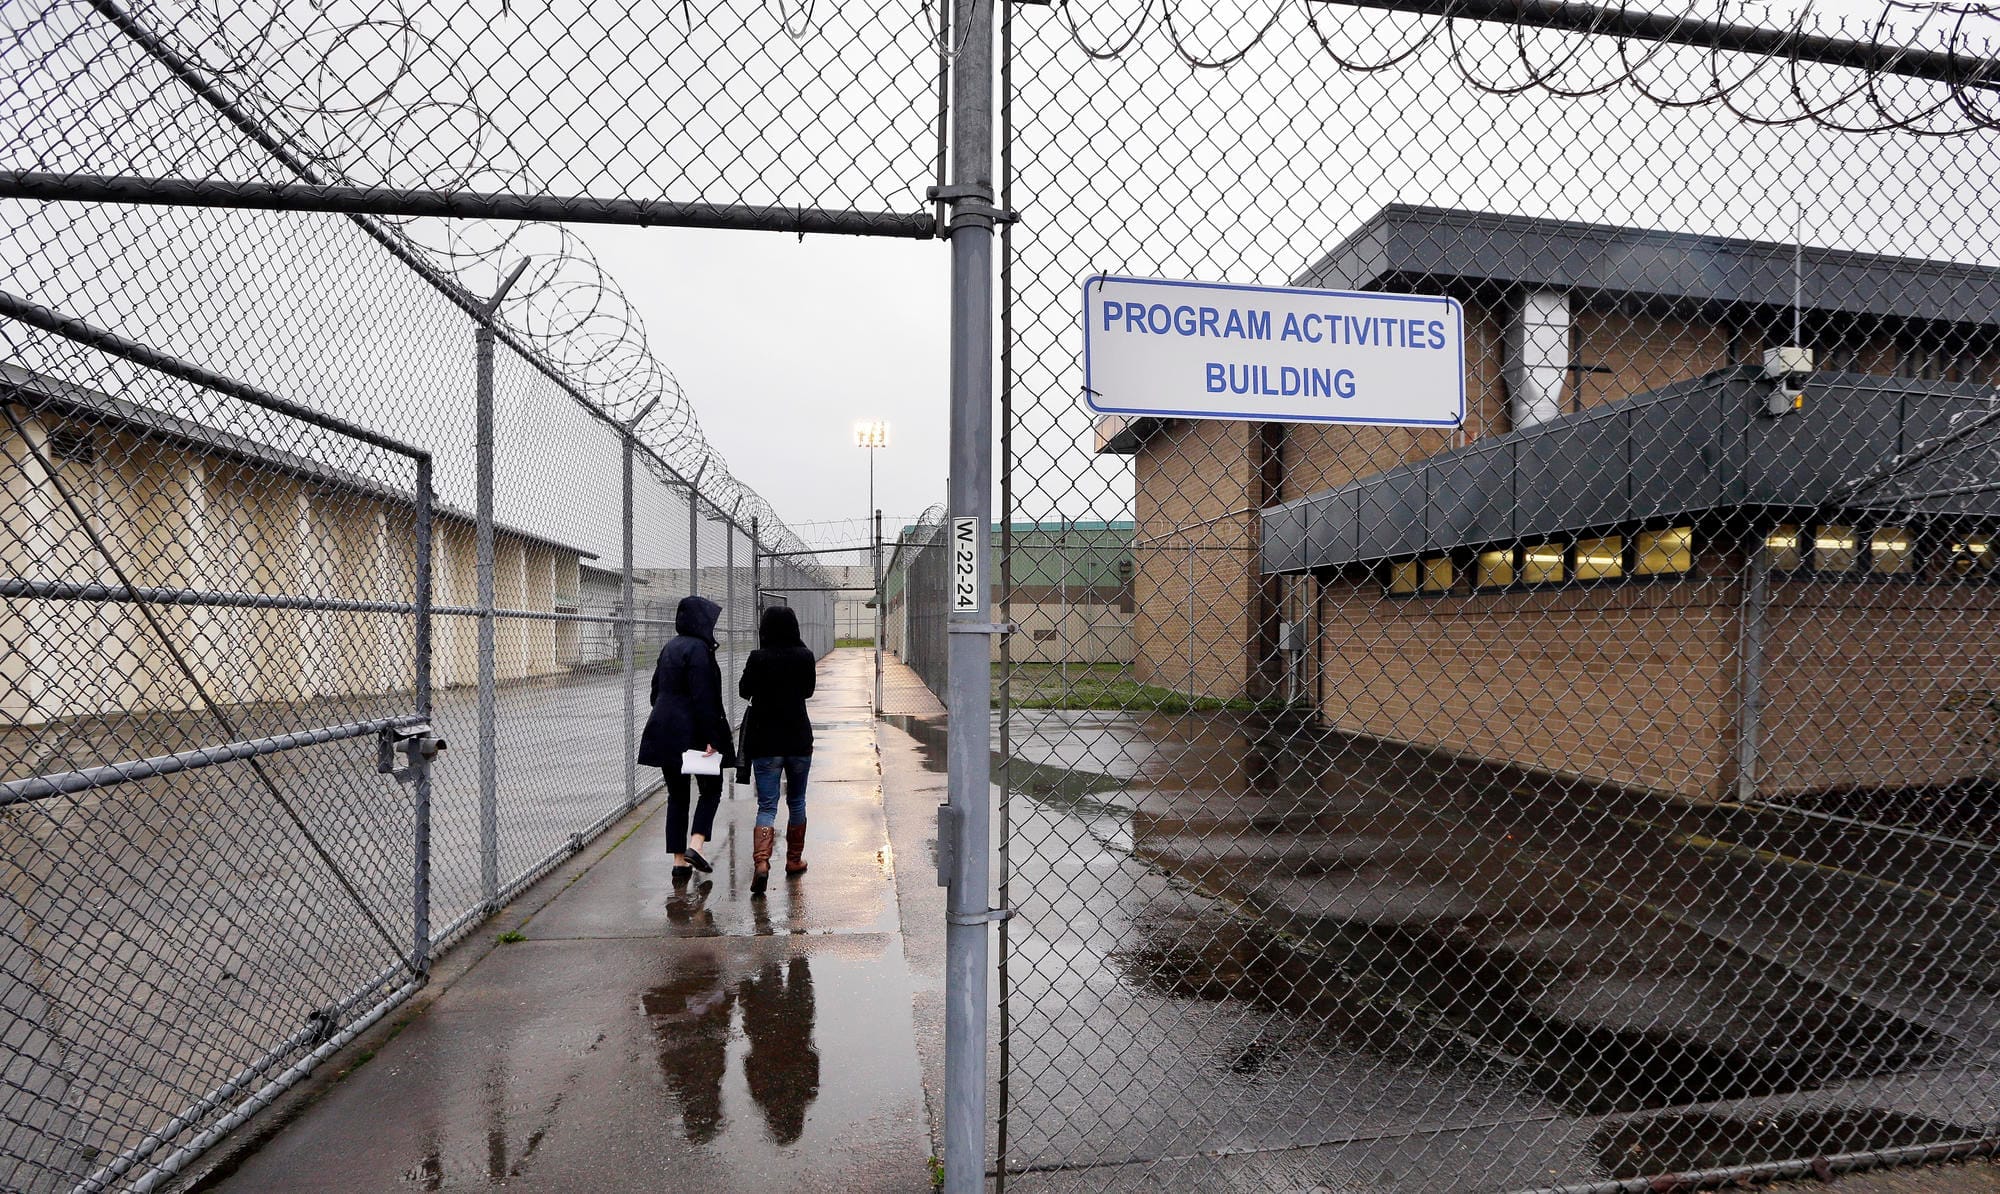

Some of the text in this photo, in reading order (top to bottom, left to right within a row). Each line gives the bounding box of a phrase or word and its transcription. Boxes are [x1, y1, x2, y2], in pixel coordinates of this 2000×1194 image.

[1103, 301, 1446, 350] PROGRAM ACTIVITIES
[1206, 362, 1356, 399] BUILDING
[956, 521, 974, 608] W-22-24
